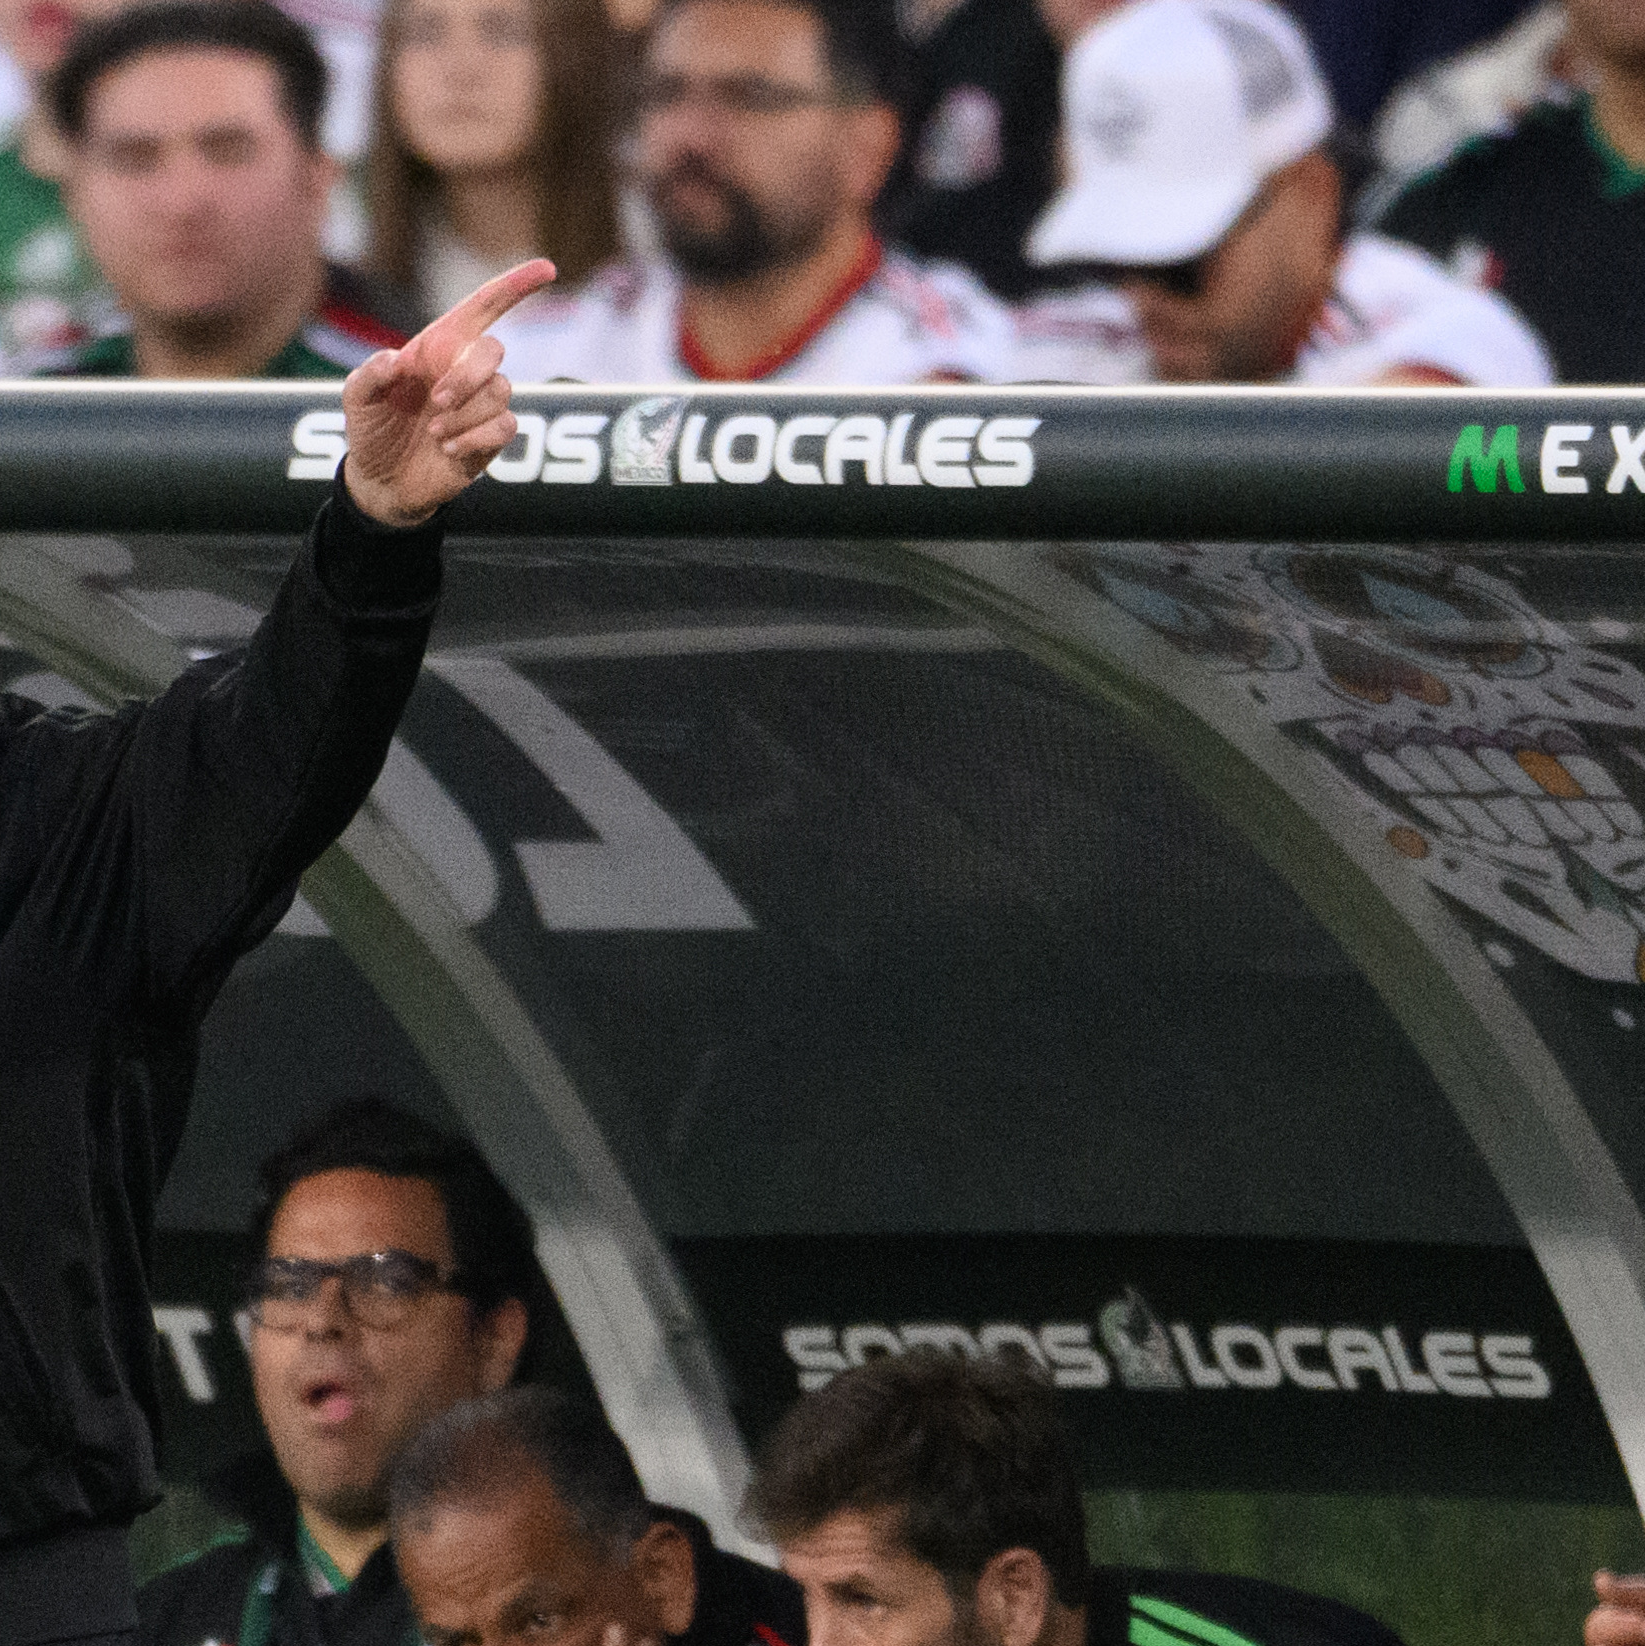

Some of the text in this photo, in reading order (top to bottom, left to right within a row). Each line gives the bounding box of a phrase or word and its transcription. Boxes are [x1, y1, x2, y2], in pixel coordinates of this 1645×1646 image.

[287, 410, 1041, 488] SOS LOCALES
[1171, 1326, 1551, 1398] LOCALES
